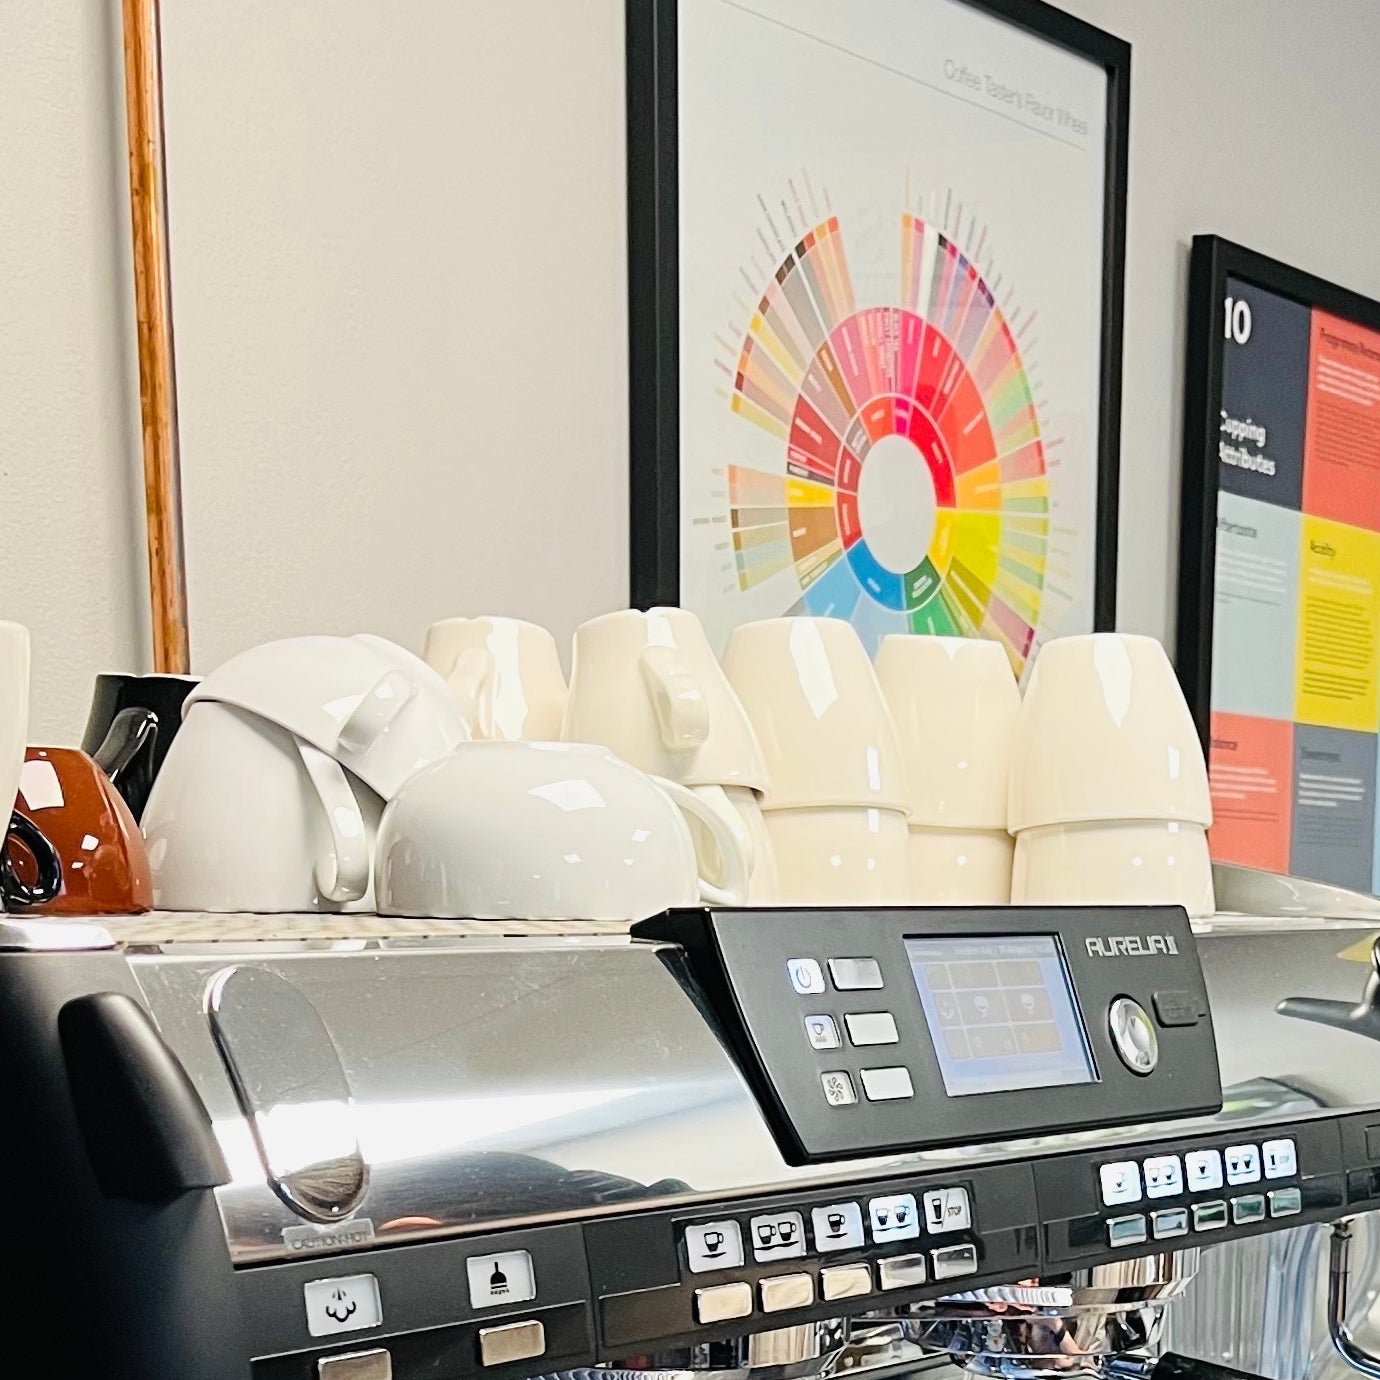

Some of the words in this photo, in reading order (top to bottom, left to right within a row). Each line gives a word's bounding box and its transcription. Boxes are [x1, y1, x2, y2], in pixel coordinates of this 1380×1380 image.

[1224, 297, 1252, 345] 10
[1220, 411, 1267, 448] upping
[1085, 936, 1167, 957] AURELIA
